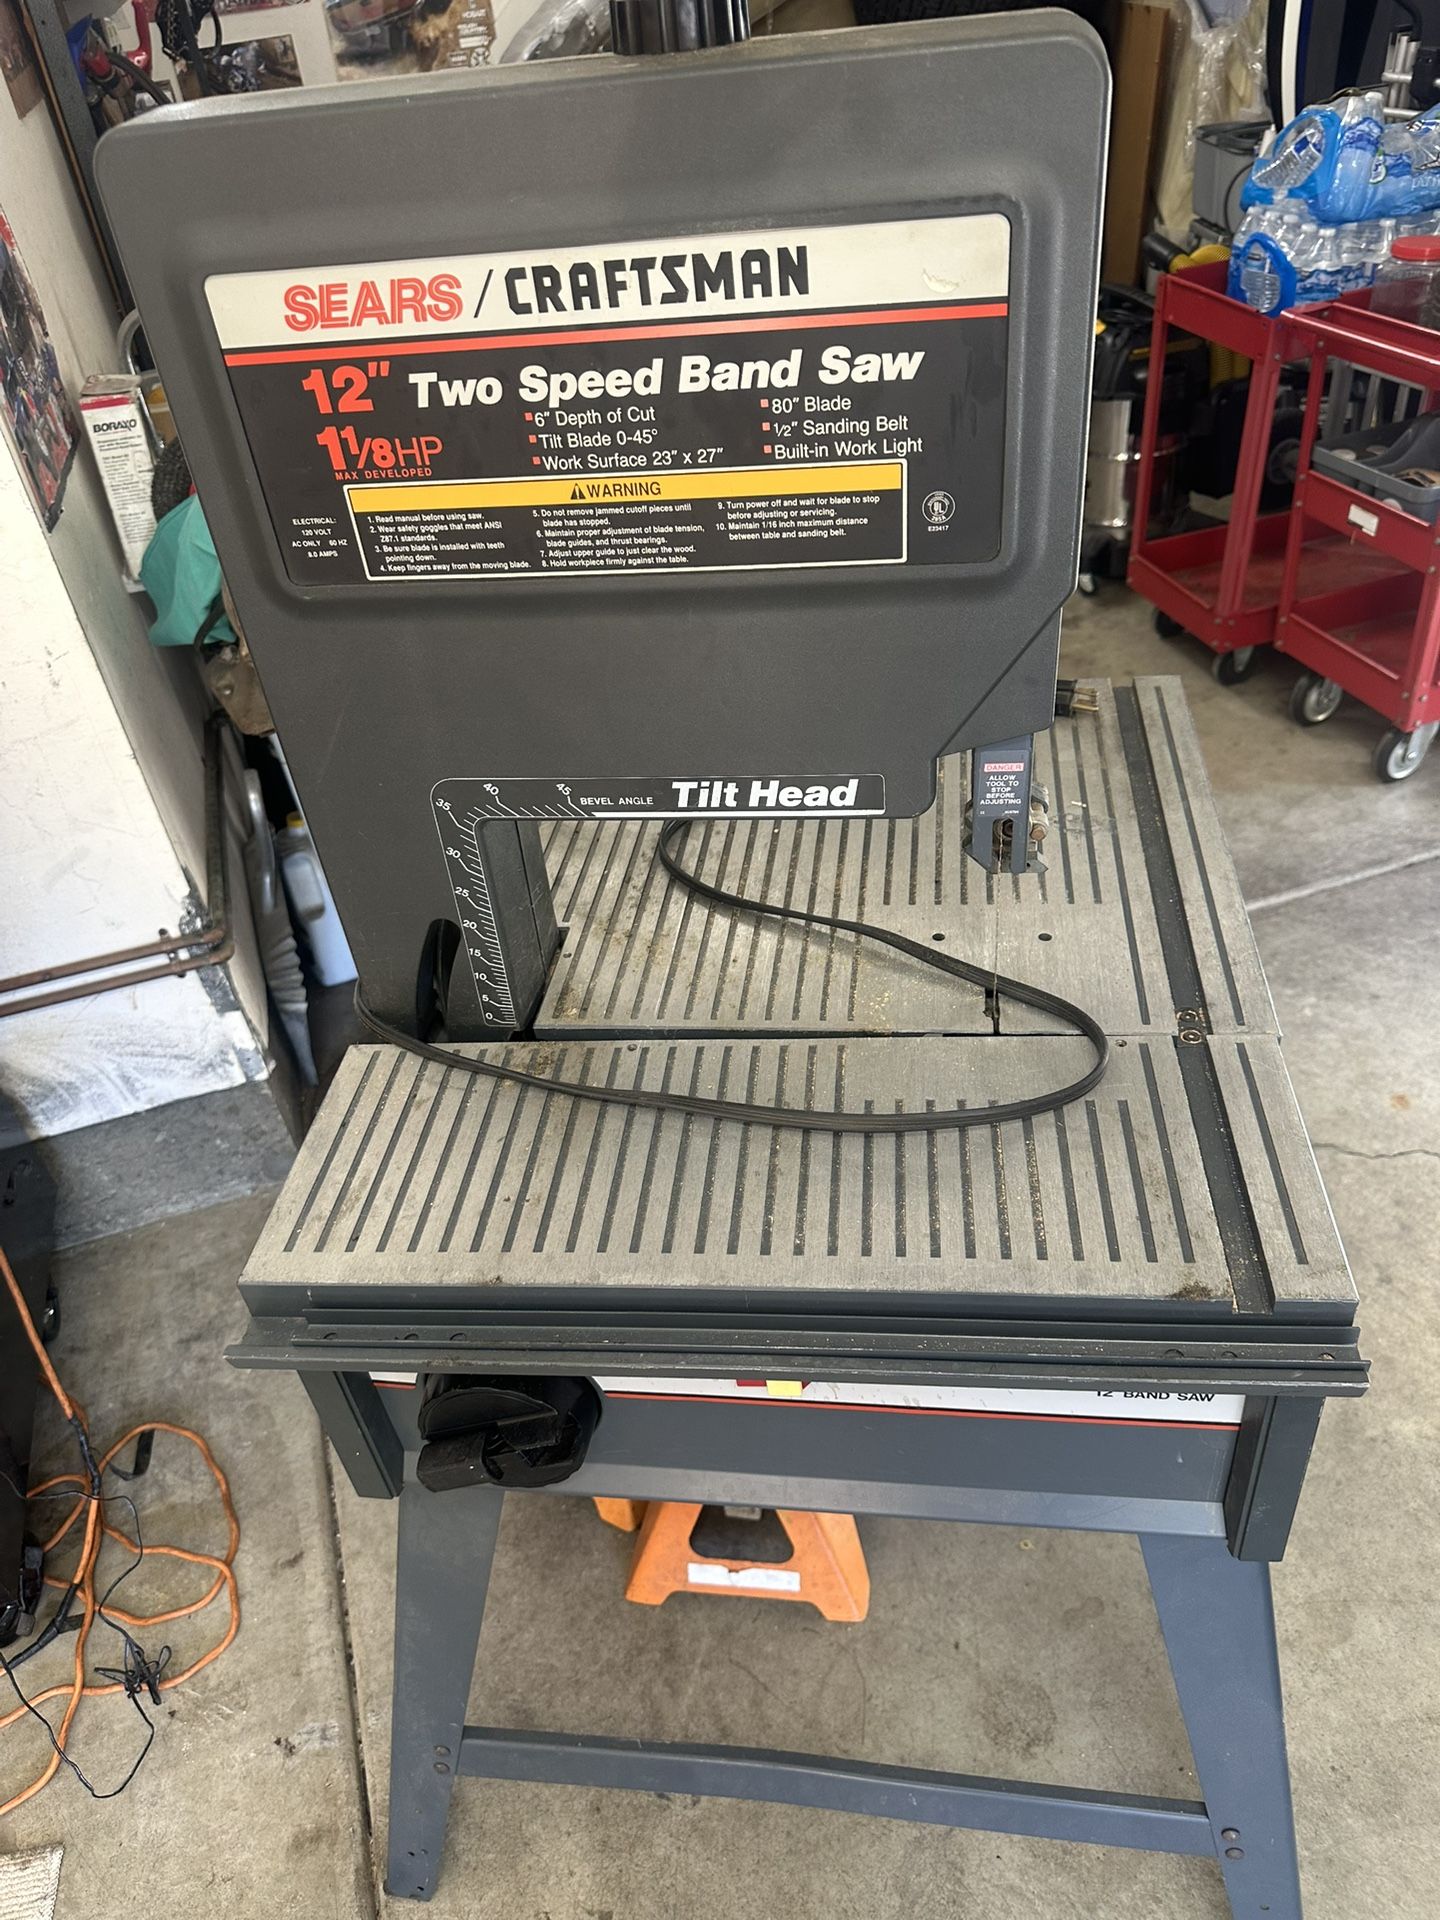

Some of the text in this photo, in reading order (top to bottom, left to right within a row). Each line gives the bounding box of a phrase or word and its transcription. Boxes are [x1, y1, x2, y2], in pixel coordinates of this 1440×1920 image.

[284, 274, 462, 332] SEARS
[504, 246, 808, 314] CRAFTSMAN
[301, 345, 925, 414] 12" Two Speed Band Saw
[771, 396, 851, 415] 80" Blade
[534, 406, 656, 427] 6" Depth of Cut
[93, 419, 137, 433] BORAXO
[803, 418, 872, 438] Sanding
[876, 416, 908, 431] Belt
[539, 428, 658, 449] Tilt Blade 0-45°
[774, 437, 923, 460] Built-in Work Light
[542, 448, 723, 471] Work Surface 23" x 27"
[335, 468, 432, 480] MAX DEVELOPED
[587, 482, 661, 498] WARNING
[726, 500, 744, 509] Turn
[745, 501, 769, 510] power
[770, 499, 781, 507] off
[782, 498, 797, 506] and
[799, 498, 815, 506] wait
[816, 497, 828, 505] for
[829, 496, 851, 505] blade
[862, 495, 880, 505] stop
[552, 508, 565, 516] not
[595, 505, 624, 516] jammed
[625, 504, 647, 513] cutoff
[648, 504, 673, 514] pieces
[674, 503, 691, 511] until
[727, 510, 751, 518] before
[752, 509, 788, 520] adjusting
[799, 508, 837, 518] servicing.
[292, 516, 336, 524] ELECTRICAL:
[375, 514, 393, 522] Read
[394, 514, 421, 522] manual
[421, 513, 445, 521] before
[446, 512, 466, 522] using
[542, 516, 610, 527] blade has stopped.
[728, 516, 868, 530] Maintain 1/16 inch maximum distance
[313, 527, 331, 536] VOLT
[377, 521, 502, 534] Wear safety goggles that meet ANSI
[544, 528, 575, 537] Maintain
[576, 529, 600, 538] proper
[602, 526, 642, 537] adjustment
[652, 525, 673, 534] blade
[674, 524, 704, 534] tension,
[728, 528, 846, 539] between table and sanding belt.
[302, 539, 320, 547] ONLY
[380, 534, 437, 542] Z87.1 standards.
[546, 535, 667, 548] blade guides, and thrust bearings.
[410, 543, 430, 551] blade
[439, 542, 469, 550] installed
[470, 542, 485, 550] with
[486, 541, 505, 549] teeth
[548, 548, 571, 559] Adjust
[572, 549, 594, 558] upper
[595, 547, 615, 557] guide
[625, 546, 639, 556] just
[641, 546, 659, 554] clear
[660, 545, 672, 553] the
[673, 544, 696, 553] wood.
[385, 552, 436, 564] pointing down.
[550, 555, 688, 568] Hold workpiece firmly against the table.
[387, 560, 531, 573] Keep fingers away from the moving blade.
[483, 782, 500, 796] 40
[555, 782, 572, 797] 45
[672, 779, 858, 808] Tilt Head
[435, 798, 451, 811] 35
[580, 796, 653, 806] BEVEL ANGLE
[446, 847, 460, 859] 30
[455, 886, 470, 898] 25
[463, 920, 477, 930] 20
[469, 948, 481, 957] 15
[474, 972, 486, 981] 10
[1123, 1392, 1169, 1400] BAND
[1177, 1393, 1214, 1402] SAW
